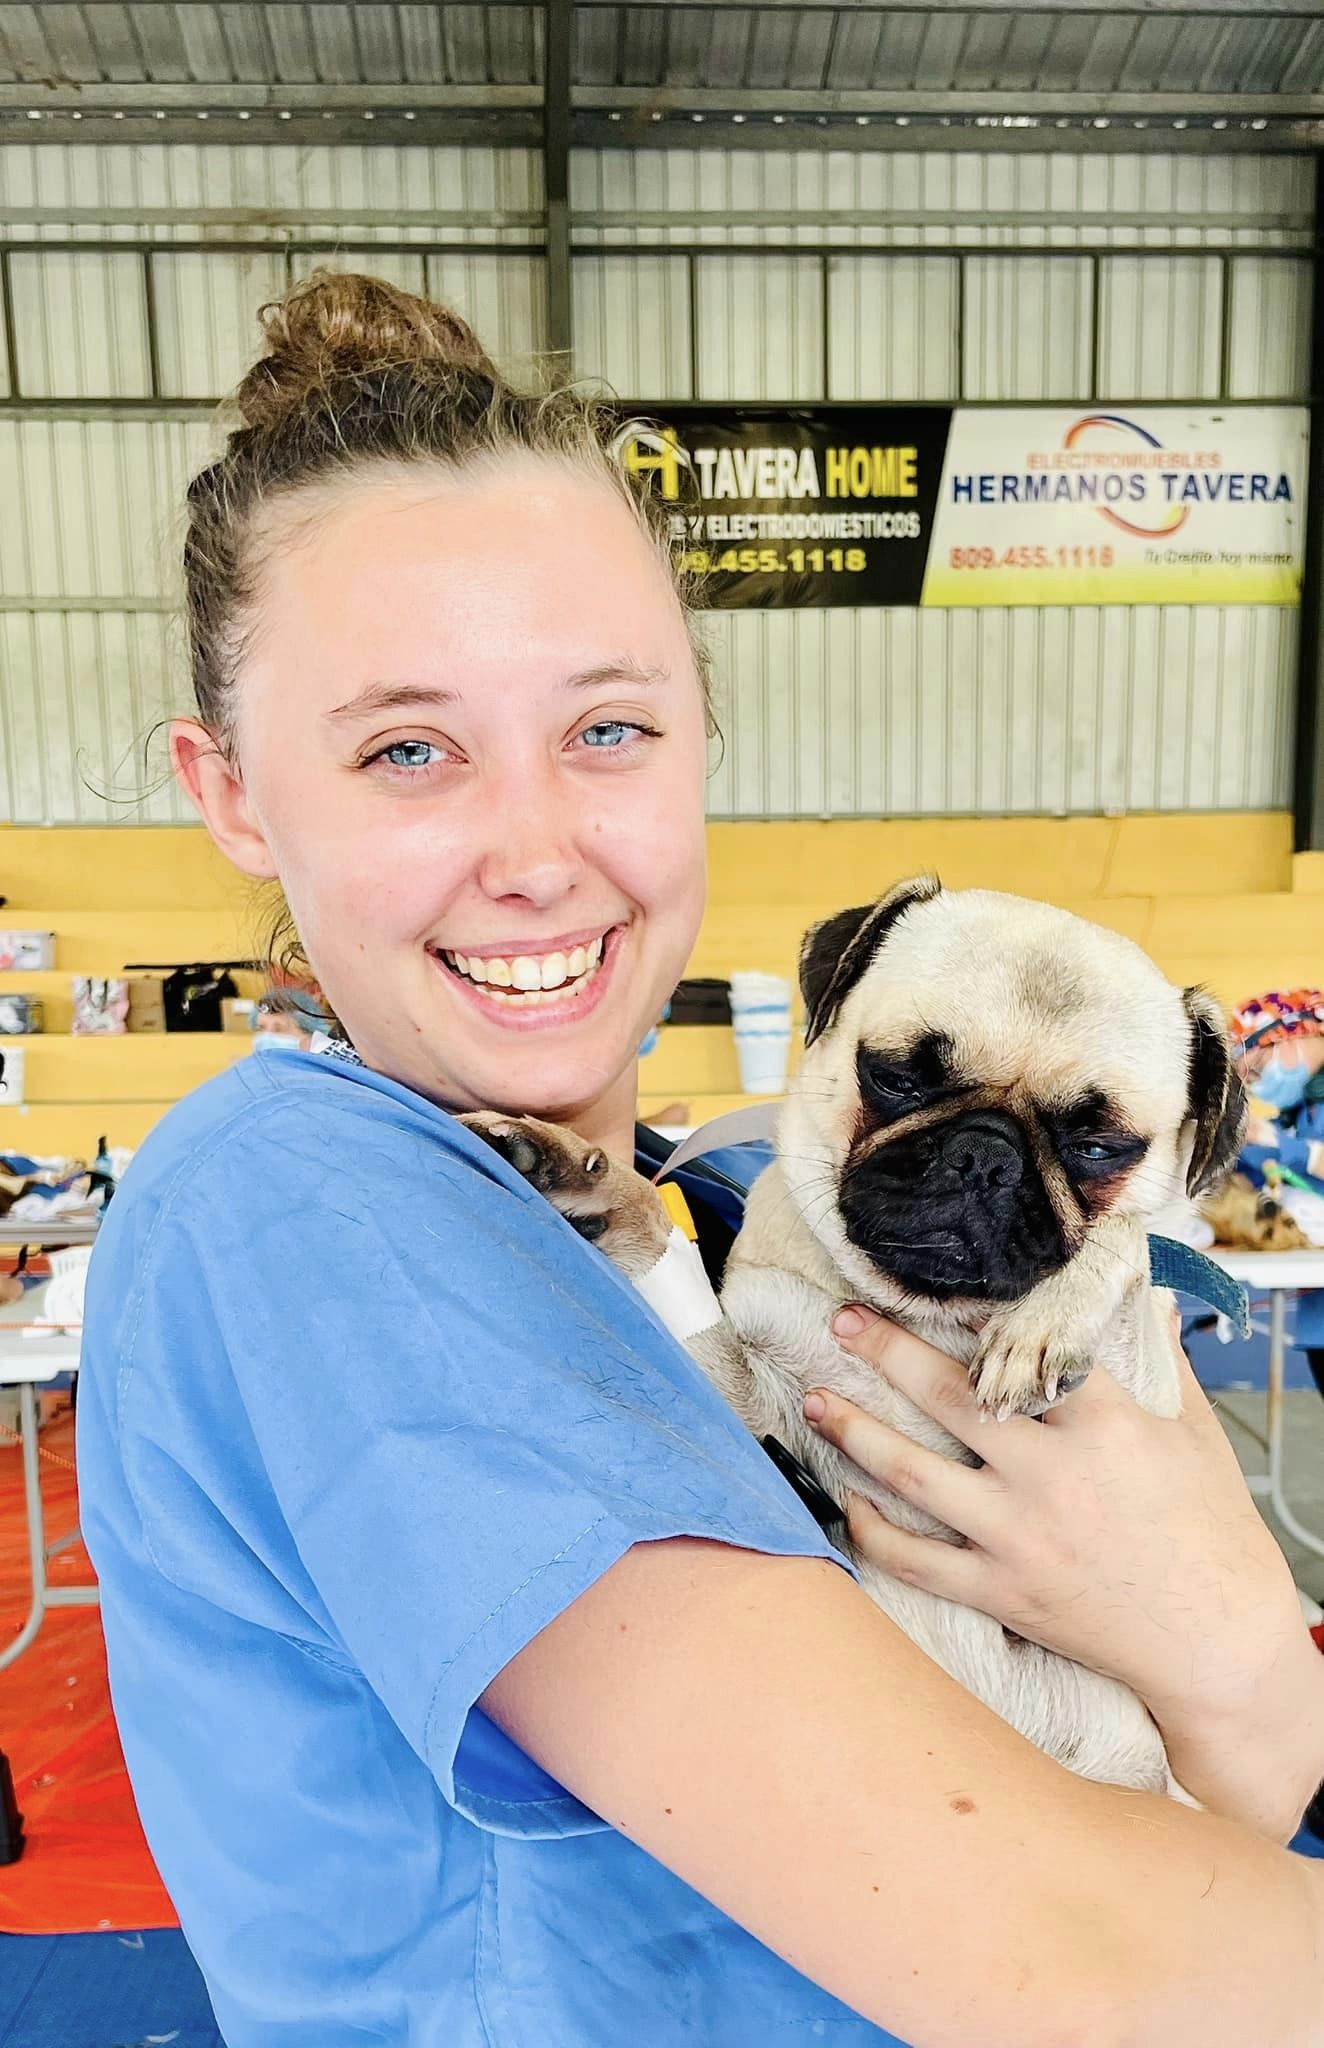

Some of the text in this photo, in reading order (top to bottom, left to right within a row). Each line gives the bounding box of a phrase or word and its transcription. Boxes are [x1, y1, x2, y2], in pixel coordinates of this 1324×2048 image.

[693, 447, 917, 500] TAVERA HOME
[1026, 451, 1222, 469] ELECTROMUEBLES
[952, 473, 1292, 503] HERMANOS TAVERA
[706, 512, 920, 540] ELECTRODOMESTICOS
[949, 546, 1114, 569] 809.455.1118
